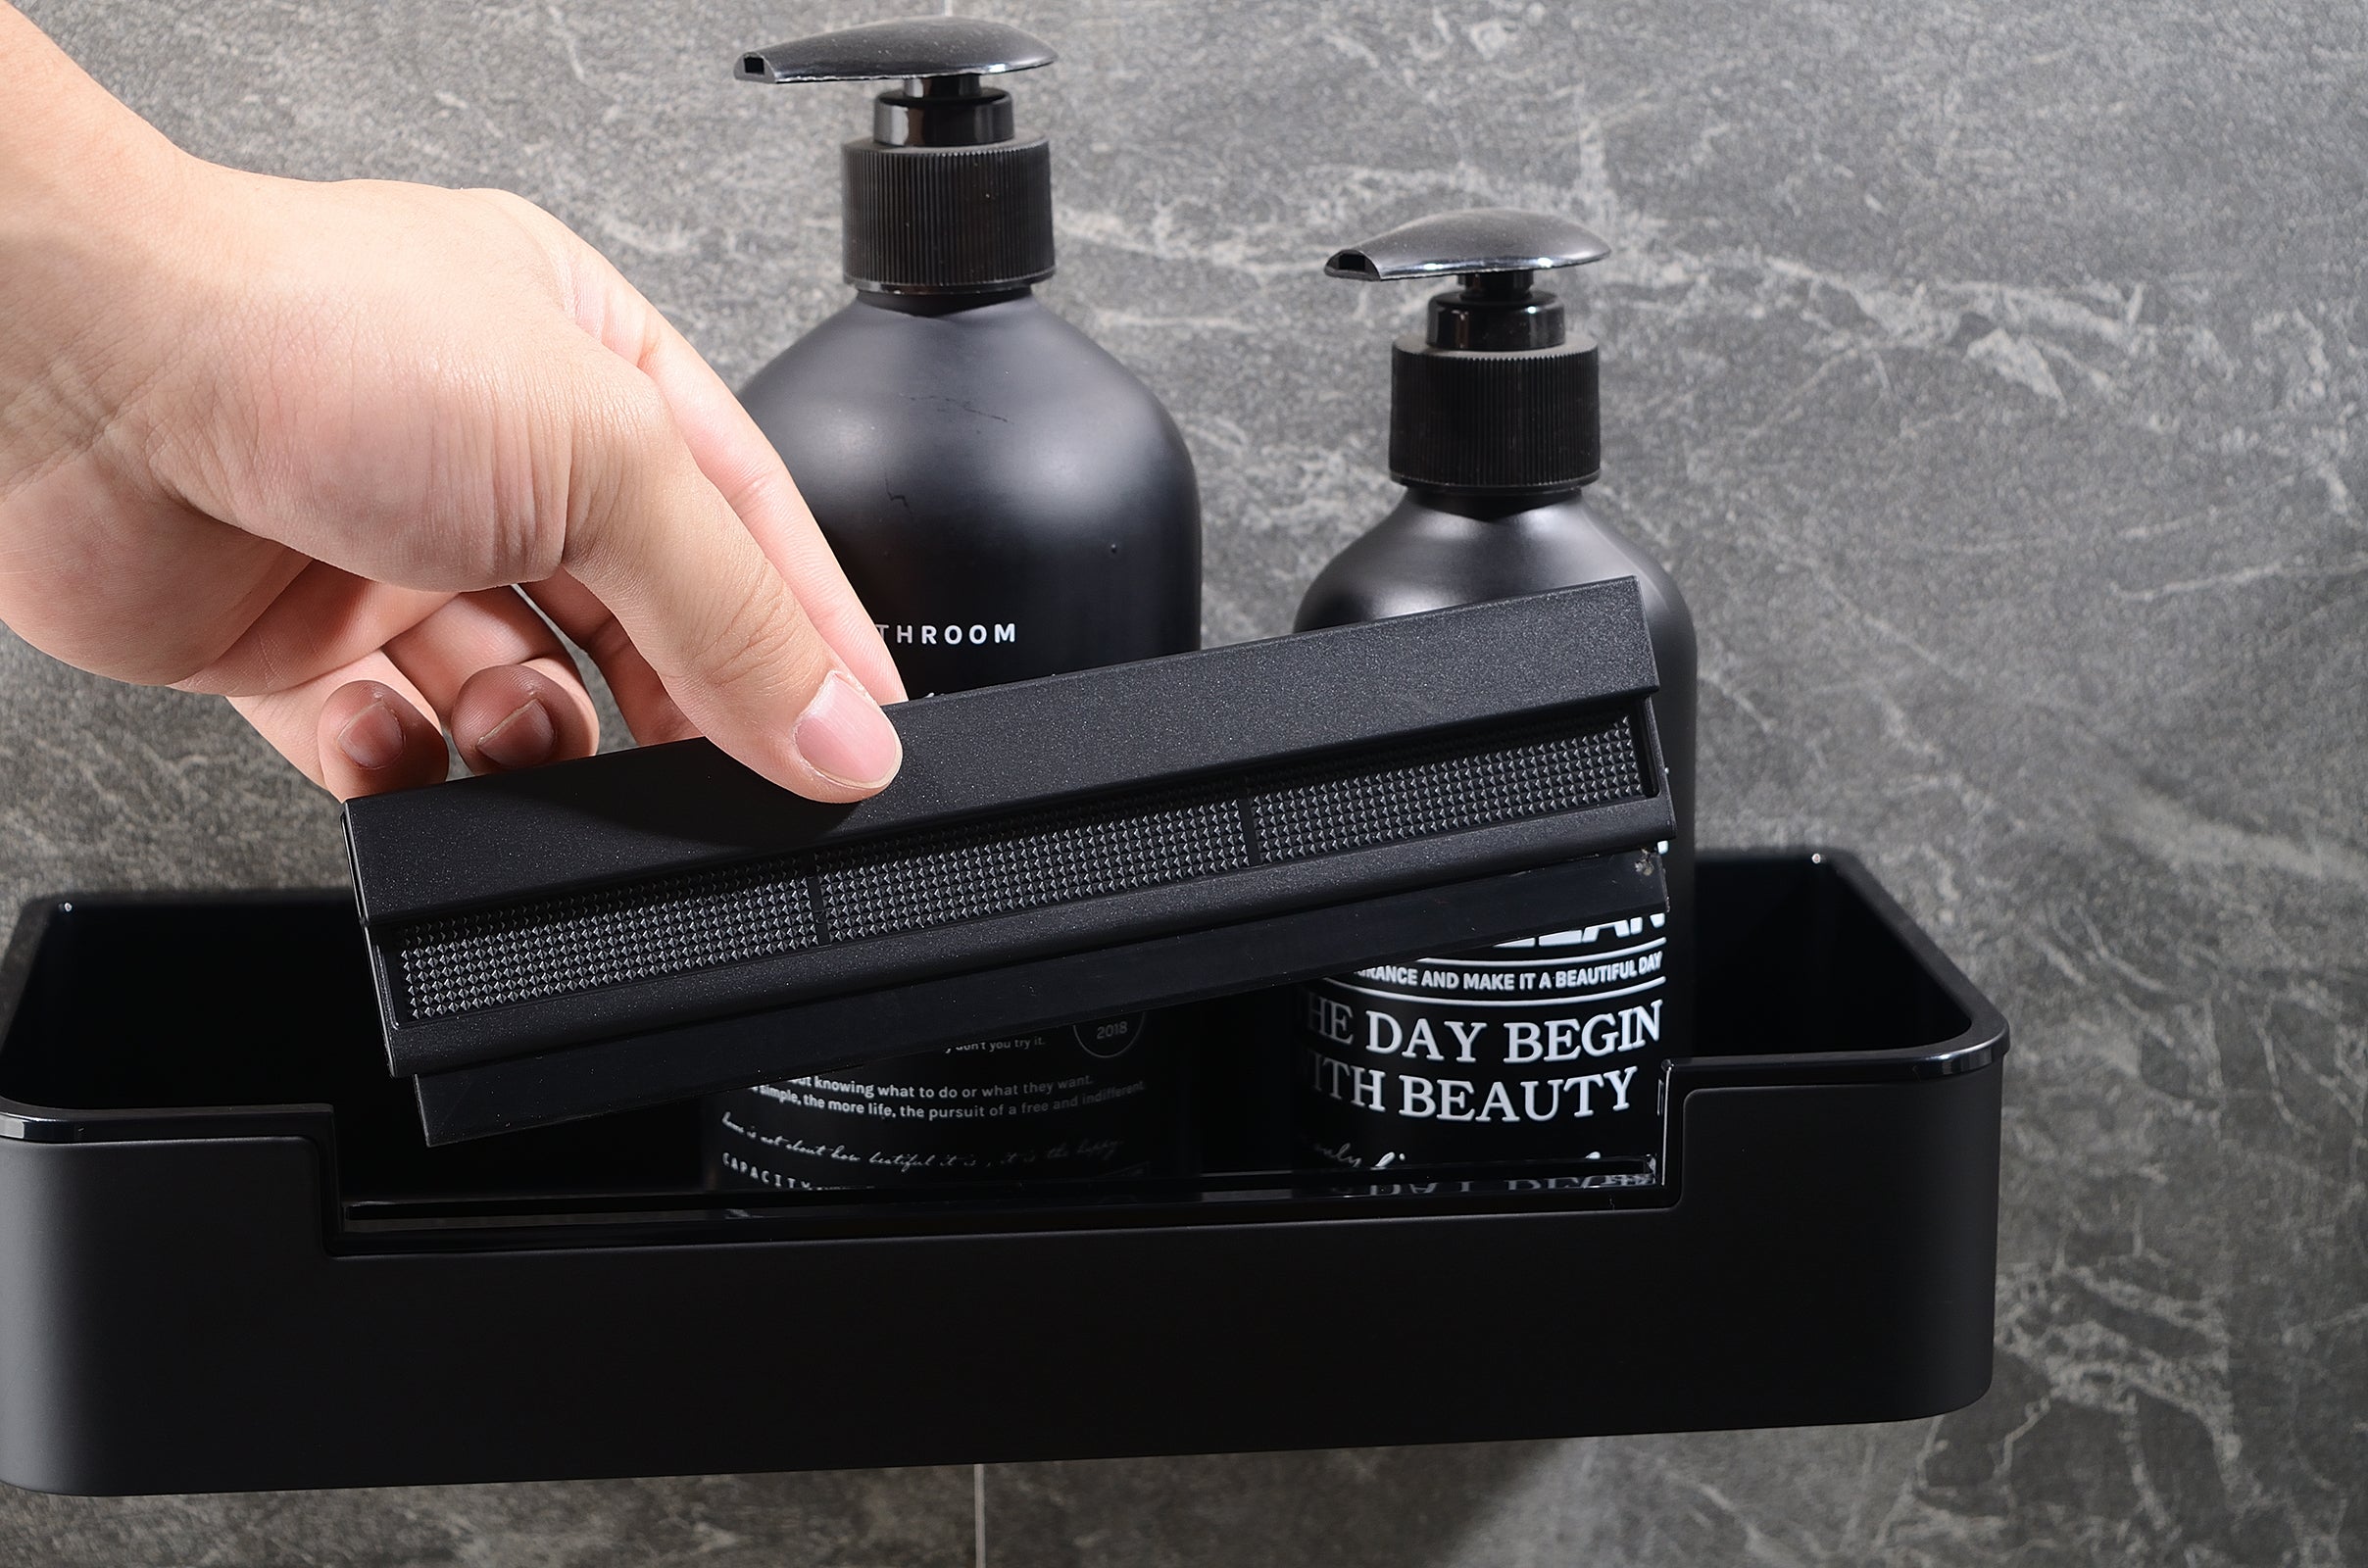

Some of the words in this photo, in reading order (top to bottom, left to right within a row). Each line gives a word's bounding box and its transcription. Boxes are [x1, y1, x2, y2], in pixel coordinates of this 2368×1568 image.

[1421, 969, 1458, 990] AND
[1462, 972, 1515, 991] MAKE
[1519, 972, 1537, 990] IT
[1539, 972, 1554, 990] A
[1555, 962, 1638, 989] BEAUTIFUL
[1638, 951, 1663, 974] DAY
[1095, 1020, 1129, 1040] 2018
[1365, 1009, 1488, 1063] DAY
[1503, 998, 1663, 1064] BEGIN
[989, 1040, 1011, 1054] you
[1014, 1038, 1032, 1051] try
[814, 1075, 874, 1099] knowing
[877, 1084, 915, 1098] what
[919, 1086, 935, 1098] to
[938, 1085, 958, 1099] do
[962, 1087, 977, 1099] or
[981, 1085, 1018, 1097] what
[1023, 1080, 1054, 1095] they
[1398, 1064, 1639, 1123] BEAUTY
[803, 1093, 825, 1109] the
[828, 1099, 865, 1114] more
[900, 1105, 925, 1119] the
[928, 1104, 985, 1121] pursuit
[989, 1103, 1005, 1117] of
[1009, 1106, 1017, 1116] a
[1021, 1102, 1049, 1114] free
[1053, 1096, 1078, 1110] and
[760, 1135, 789, 1147] not
[831, 1145, 862, 1162] how
[939, 1153, 958, 1166] it
